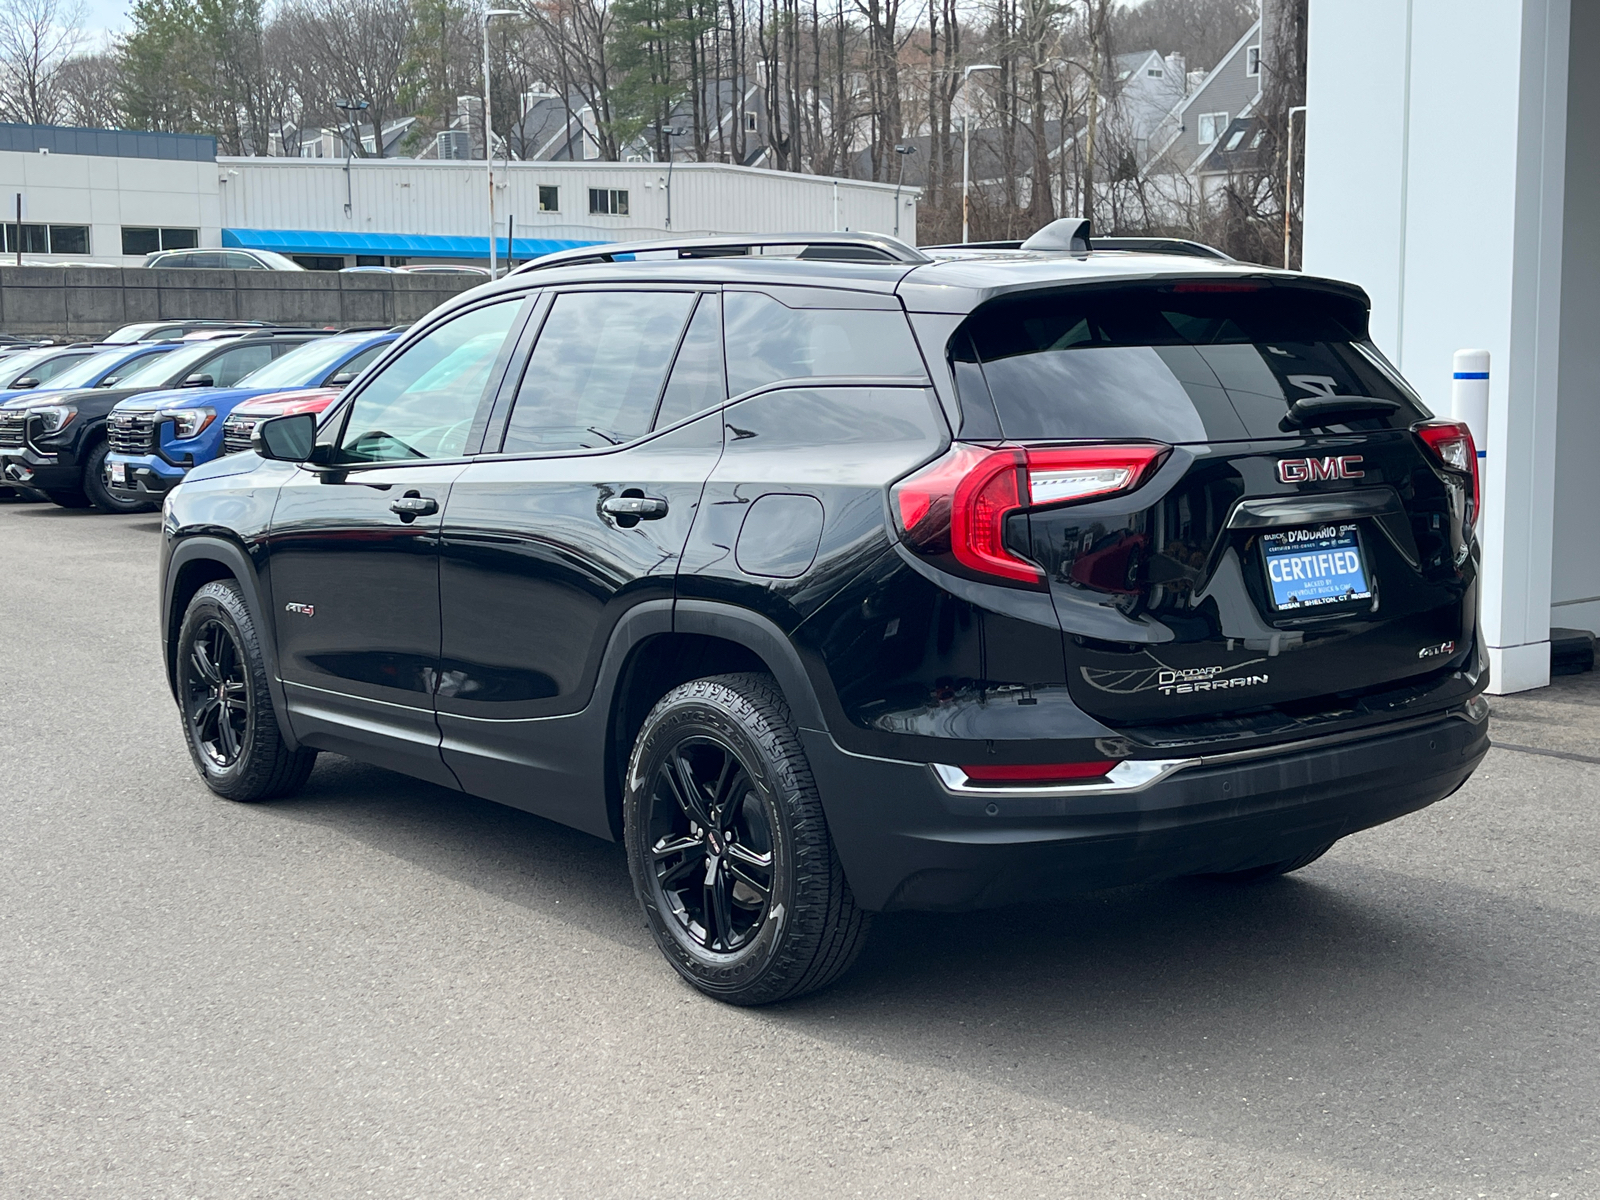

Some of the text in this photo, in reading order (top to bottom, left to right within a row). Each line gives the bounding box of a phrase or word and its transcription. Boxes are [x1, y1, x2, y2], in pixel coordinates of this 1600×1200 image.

[1277, 455, 1365, 483] GMC
[1263, 532, 1285, 541] BUICK
[1339, 523, 1357, 531] GMC
[1268, 551, 1359, 582] CERTIFIED
[1286, 588, 1317, 597] CHEVROLET
[1317, 585, 1334, 594] BUICK
[1303, 580, 1324, 589] BACKED
[1278, 601, 1301, 611] NISSAN
[1304, 596, 1338, 607] SHELTON,
[1418, 640, 1455, 659] AT4
[1158, 674, 1269, 695] TERRAIN
